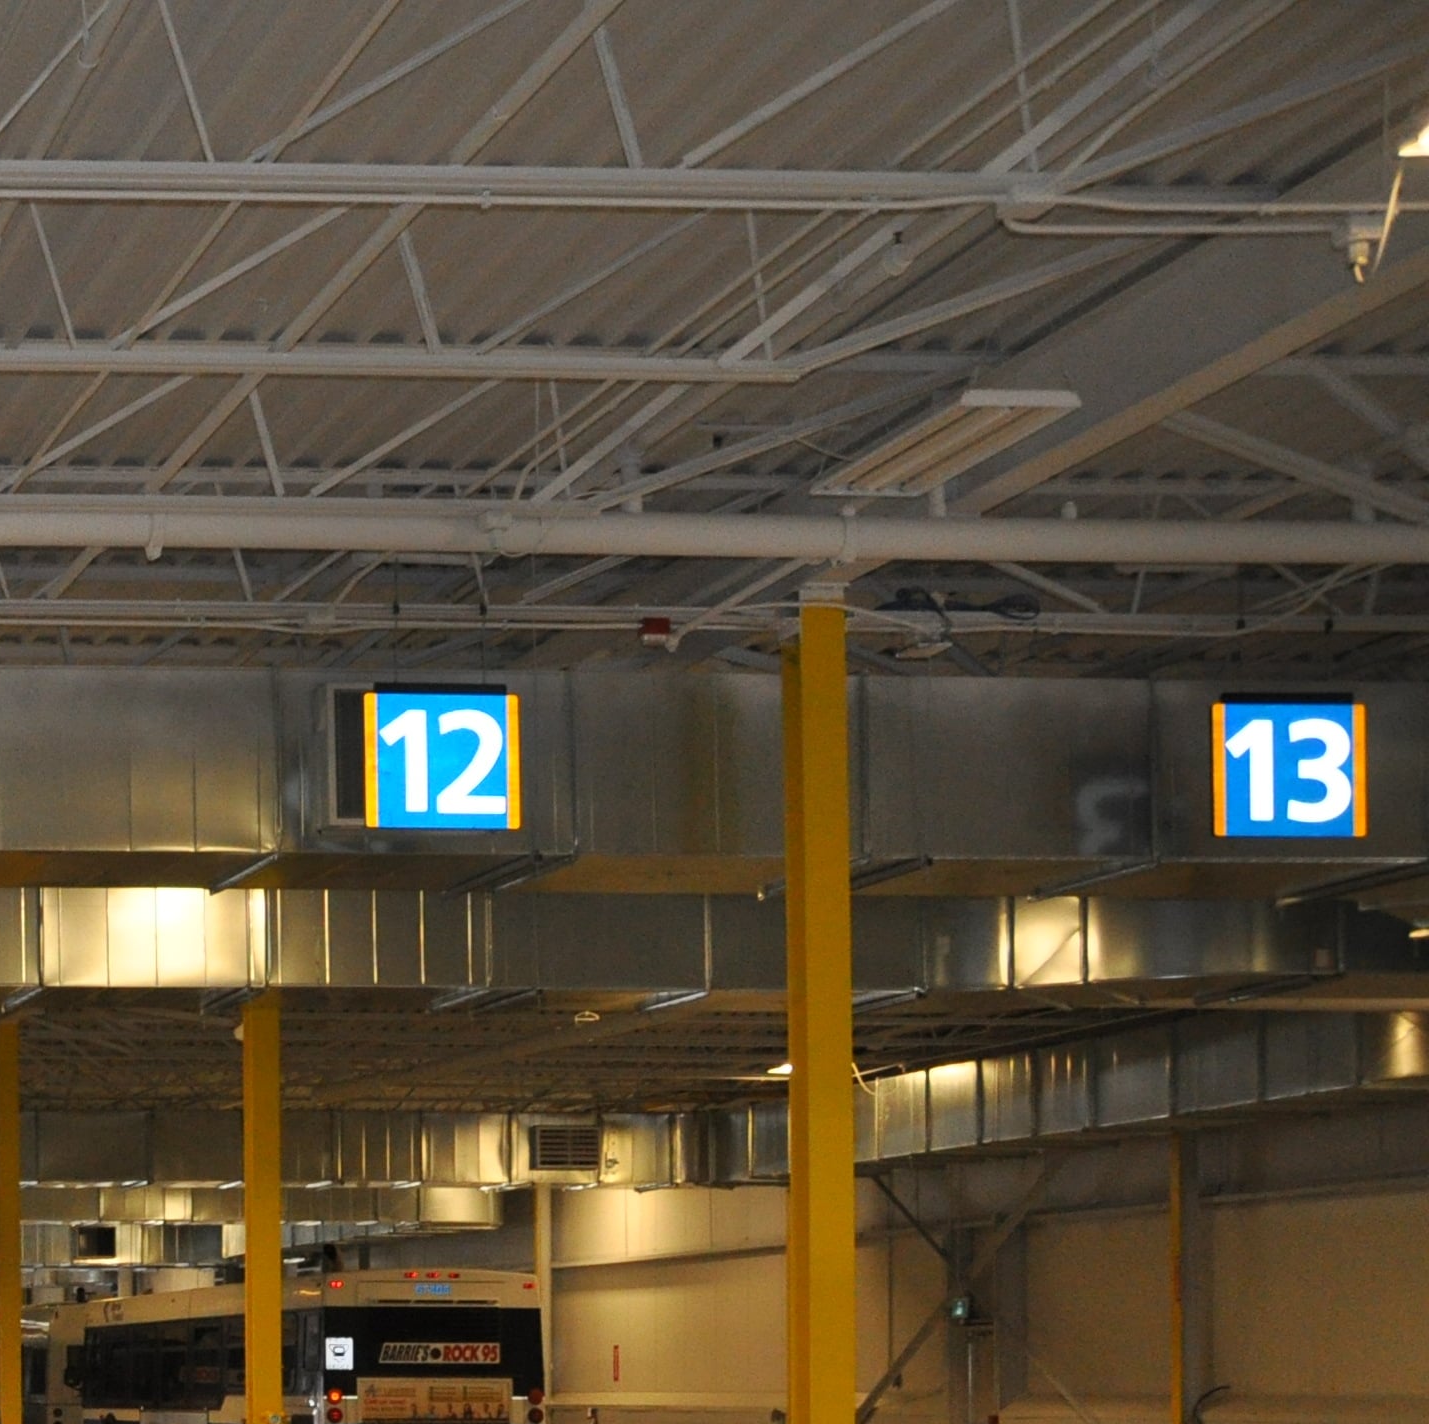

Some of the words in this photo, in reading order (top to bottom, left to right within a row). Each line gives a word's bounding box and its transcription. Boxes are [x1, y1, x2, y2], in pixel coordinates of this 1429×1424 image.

[379, 709, 506, 814] 12
[1225, 718, 1352, 824] 13
[381, 1344, 430, 1361] BARRIE'S
[442, 1344, 479, 1361] ROCK
[482, 1344, 498, 1361] 95
